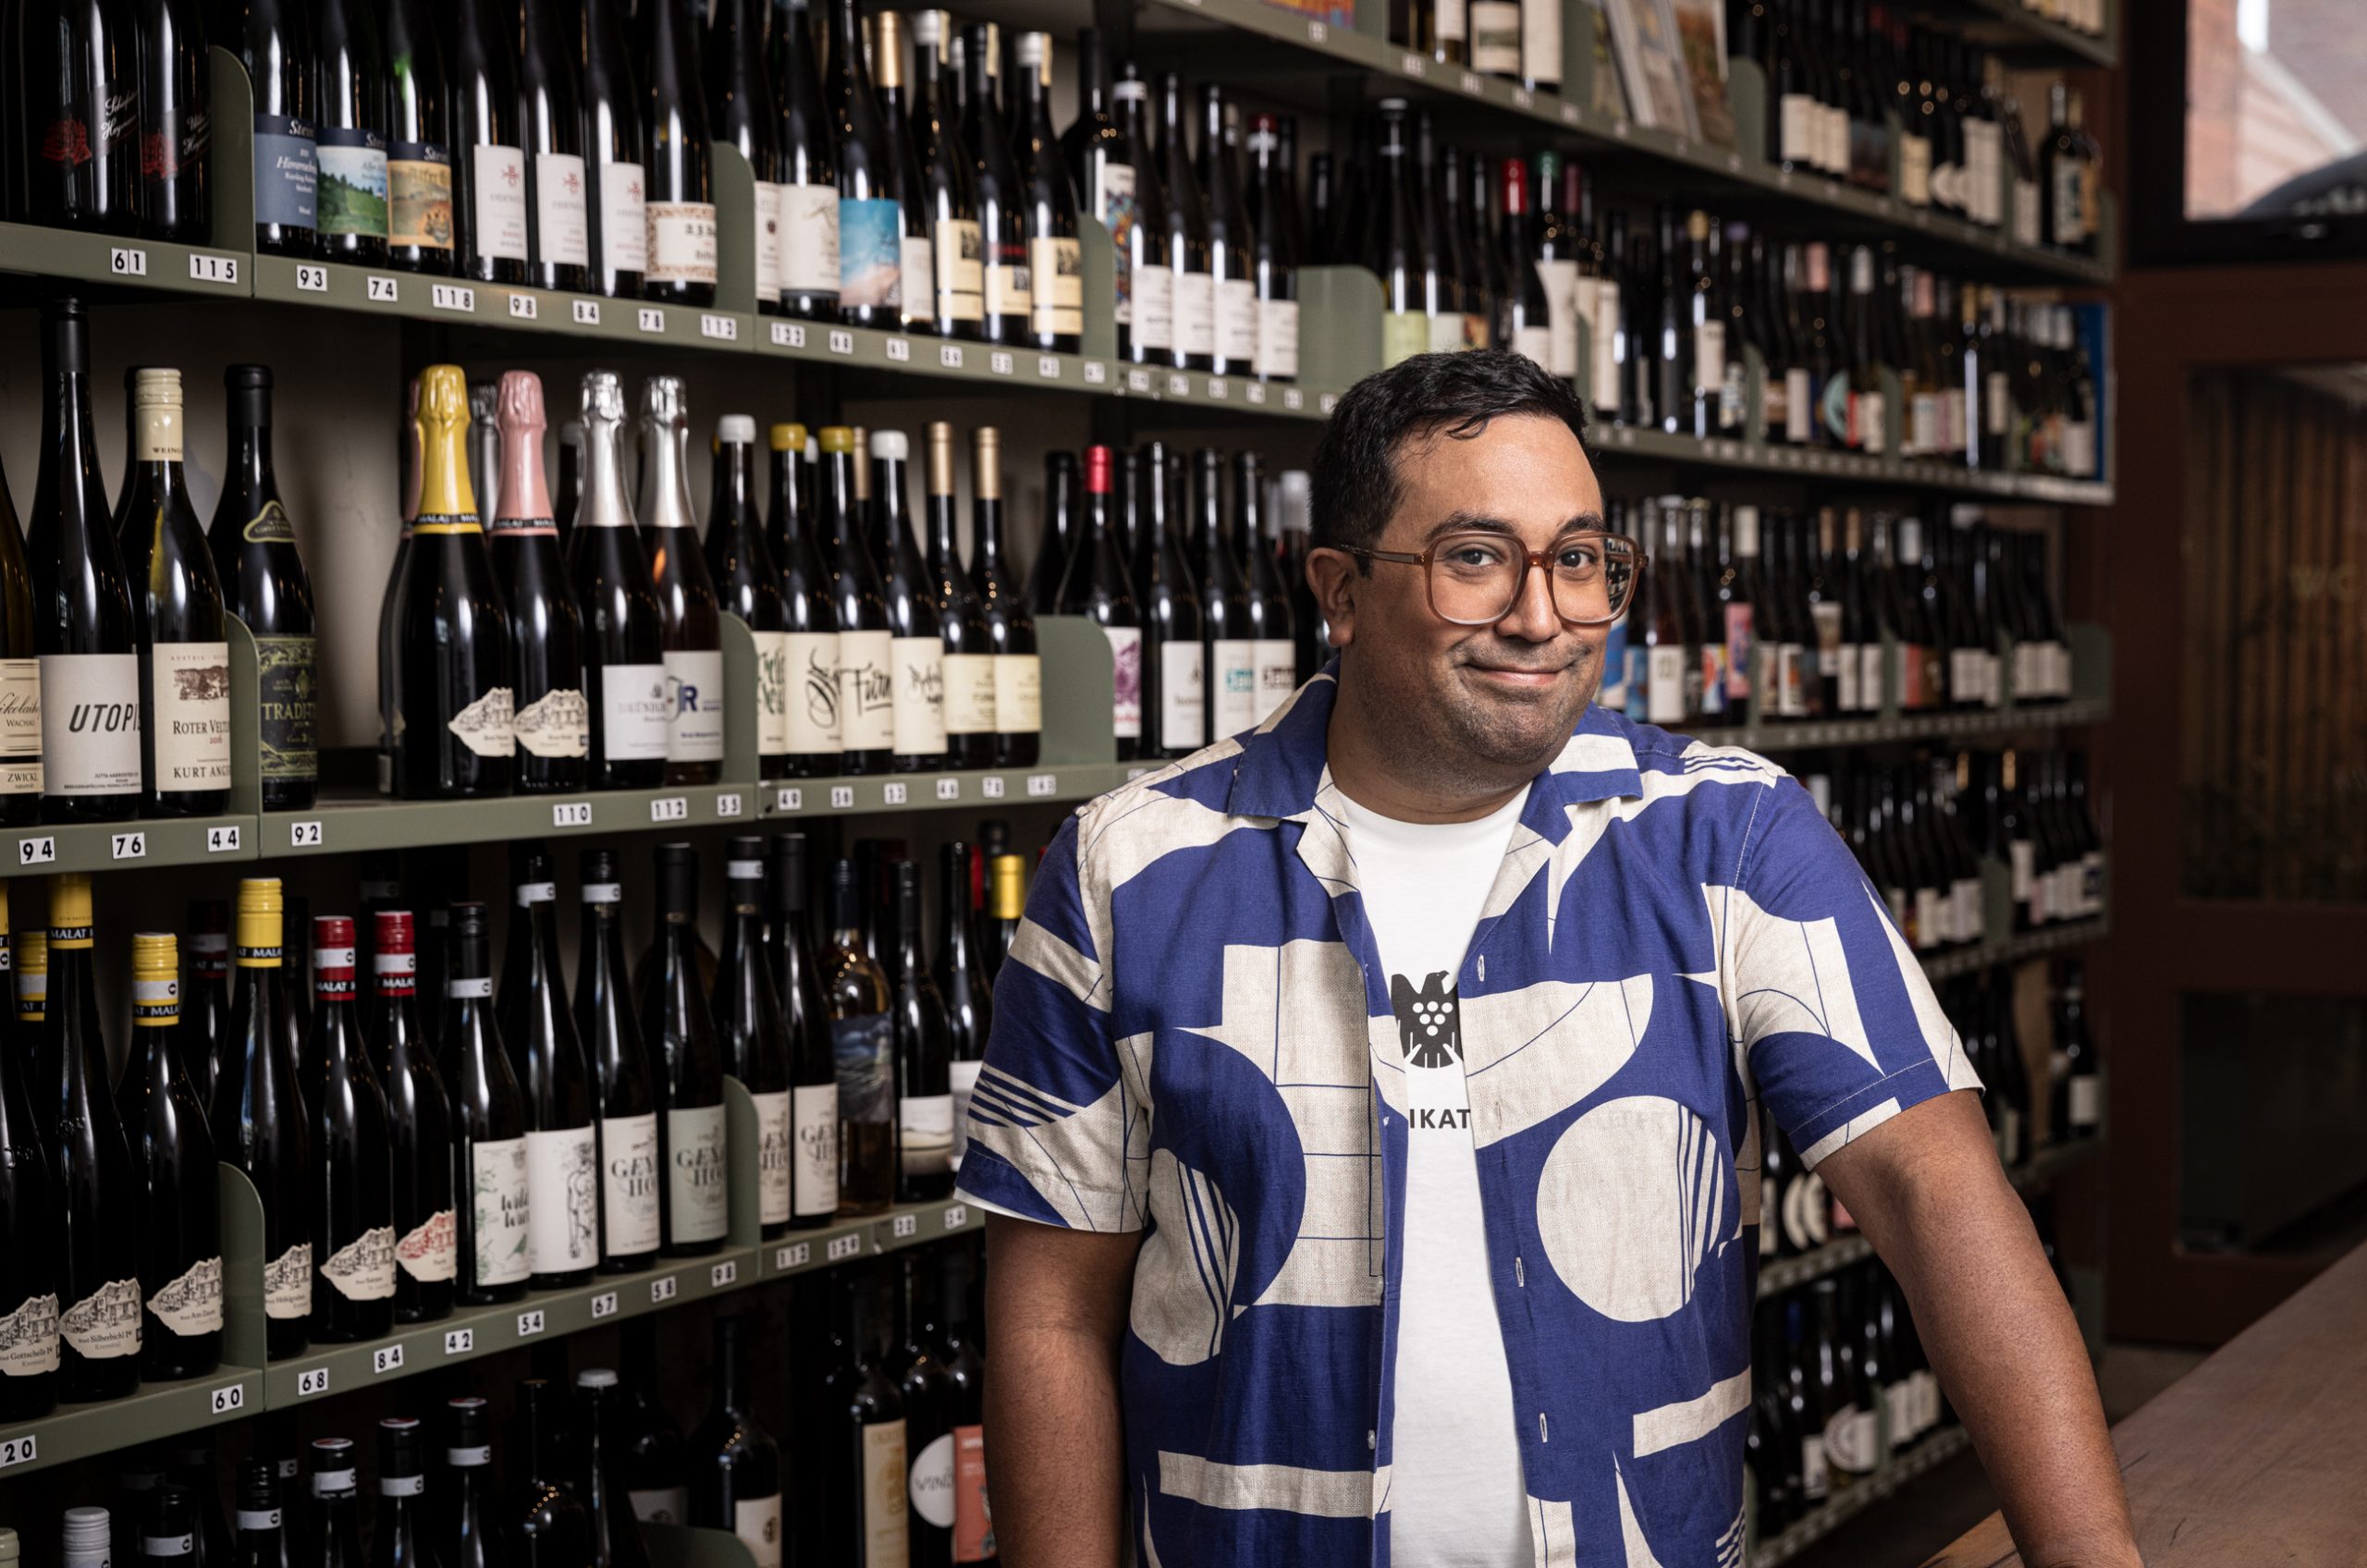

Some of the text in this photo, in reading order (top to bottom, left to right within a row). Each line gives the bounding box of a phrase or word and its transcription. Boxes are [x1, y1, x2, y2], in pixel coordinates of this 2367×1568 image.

[114, 252, 140, 271] 61
[195, 258, 234, 279] 115
[300, 269, 324, 288] 93
[372, 280, 395, 299] 74
[437, 287, 471, 308] 118
[173, 719, 207, 735] ROTER
[174, 766, 205, 778] KURT
[557, 806, 588, 822] 110
[211, 829, 238, 848] 44
[295, 825, 319, 843] 92
[22, 840, 53, 862] 94
[116, 836, 141, 855] 76
[50, 927, 86, 941] MALAT
[595, 1295, 613, 1315] 67
[521, 1314, 543, 1332] 54
[448, 1332, 471, 1352] 42
[377, 1347, 400, 1369] 84
[302, 1371, 326, 1393] 68
[215, 1387, 241, 1410] 60
[4, 1438, 33, 1464] 20
